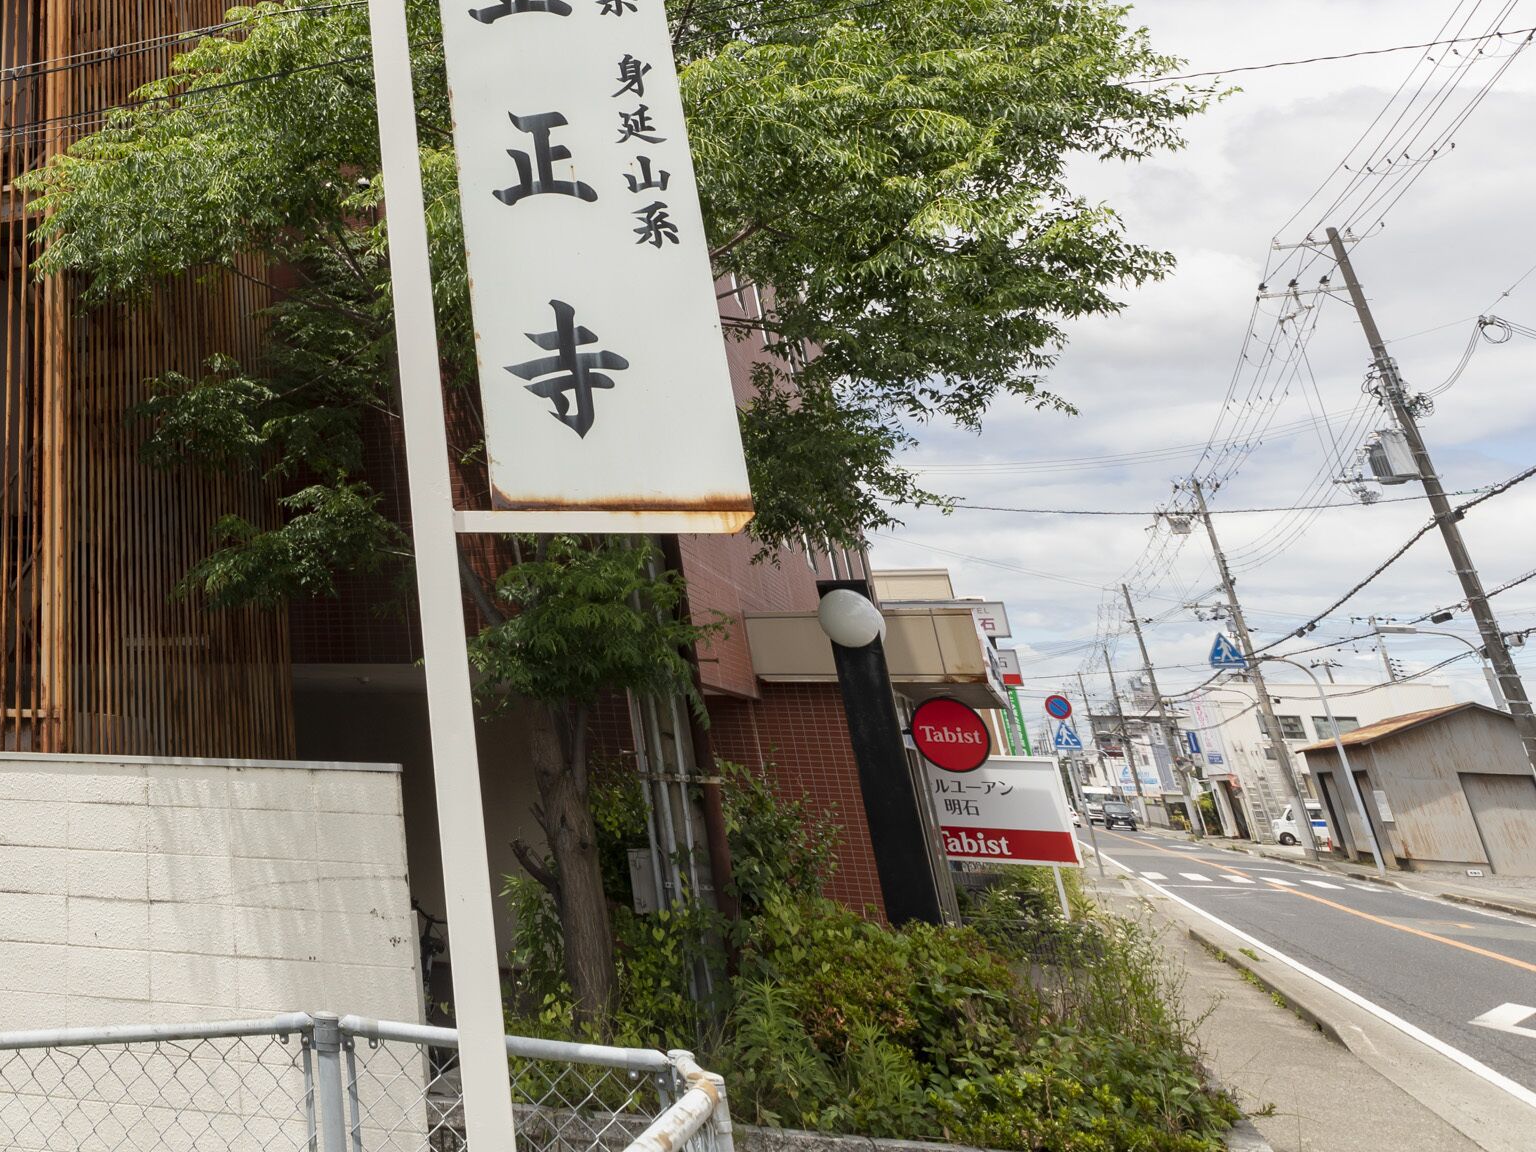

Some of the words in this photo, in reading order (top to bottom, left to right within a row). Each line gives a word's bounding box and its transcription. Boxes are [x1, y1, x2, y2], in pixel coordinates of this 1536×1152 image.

[611, 53, 681, 249] 身延山系
[919, 725, 983, 744] Tabist
[944, 798, 980, 816] 明石
